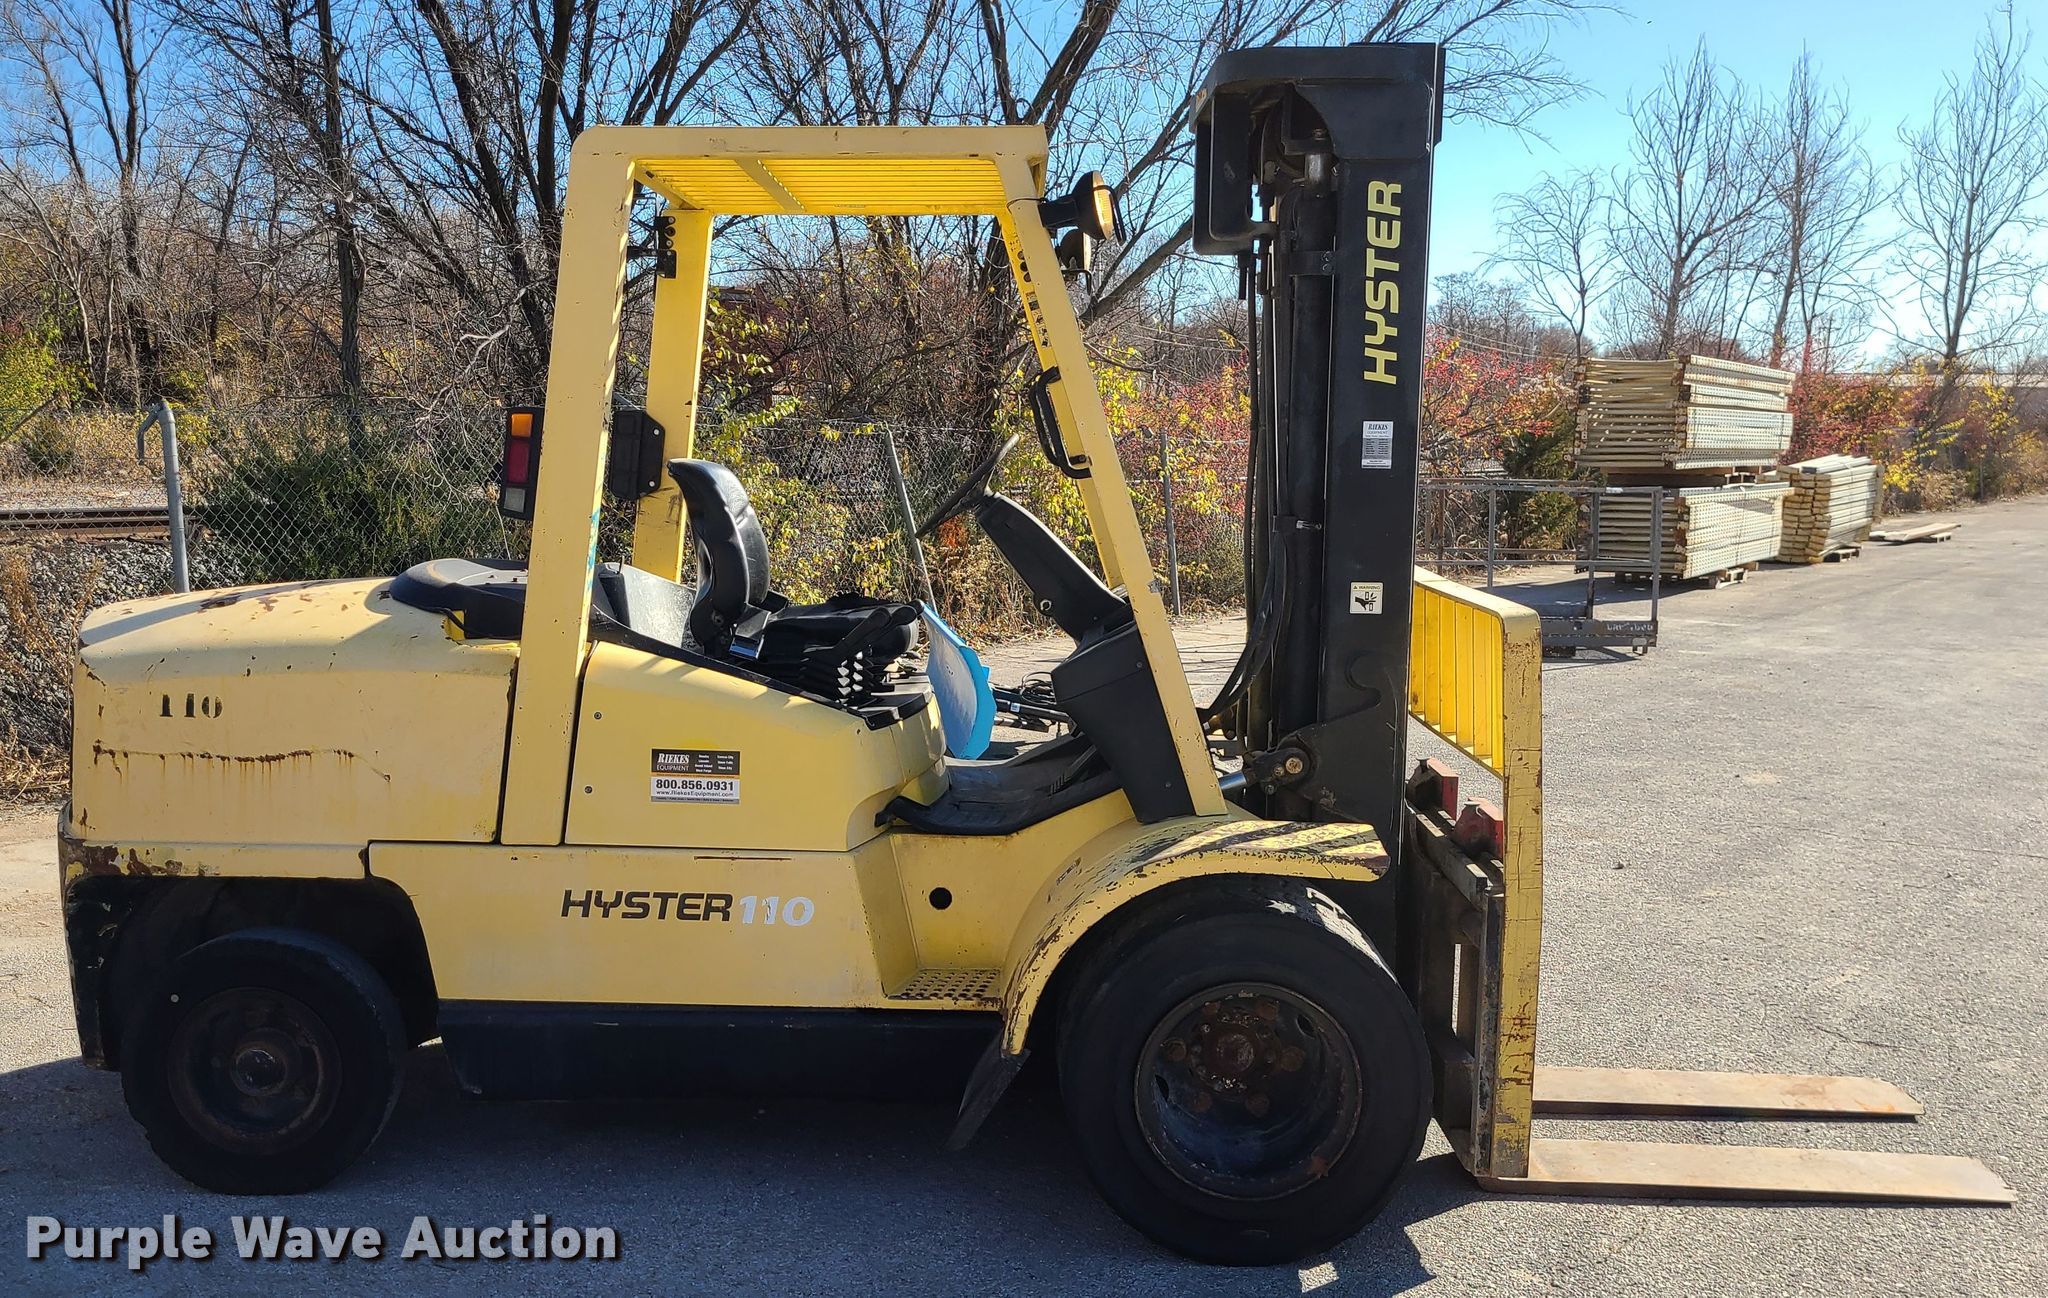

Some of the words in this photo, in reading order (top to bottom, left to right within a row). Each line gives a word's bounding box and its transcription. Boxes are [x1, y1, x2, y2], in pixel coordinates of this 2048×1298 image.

[1363, 180, 1402, 385] HYSTER
[160, 693, 223, 718] 110
[657, 753, 690, 764] RIEKES
[656, 764, 690, 772] EQUIPMENT
[656, 779, 734, 791] 800.856.0931
[561, 889, 734, 922] HYSTER
[738, 895, 815, 927] 110
